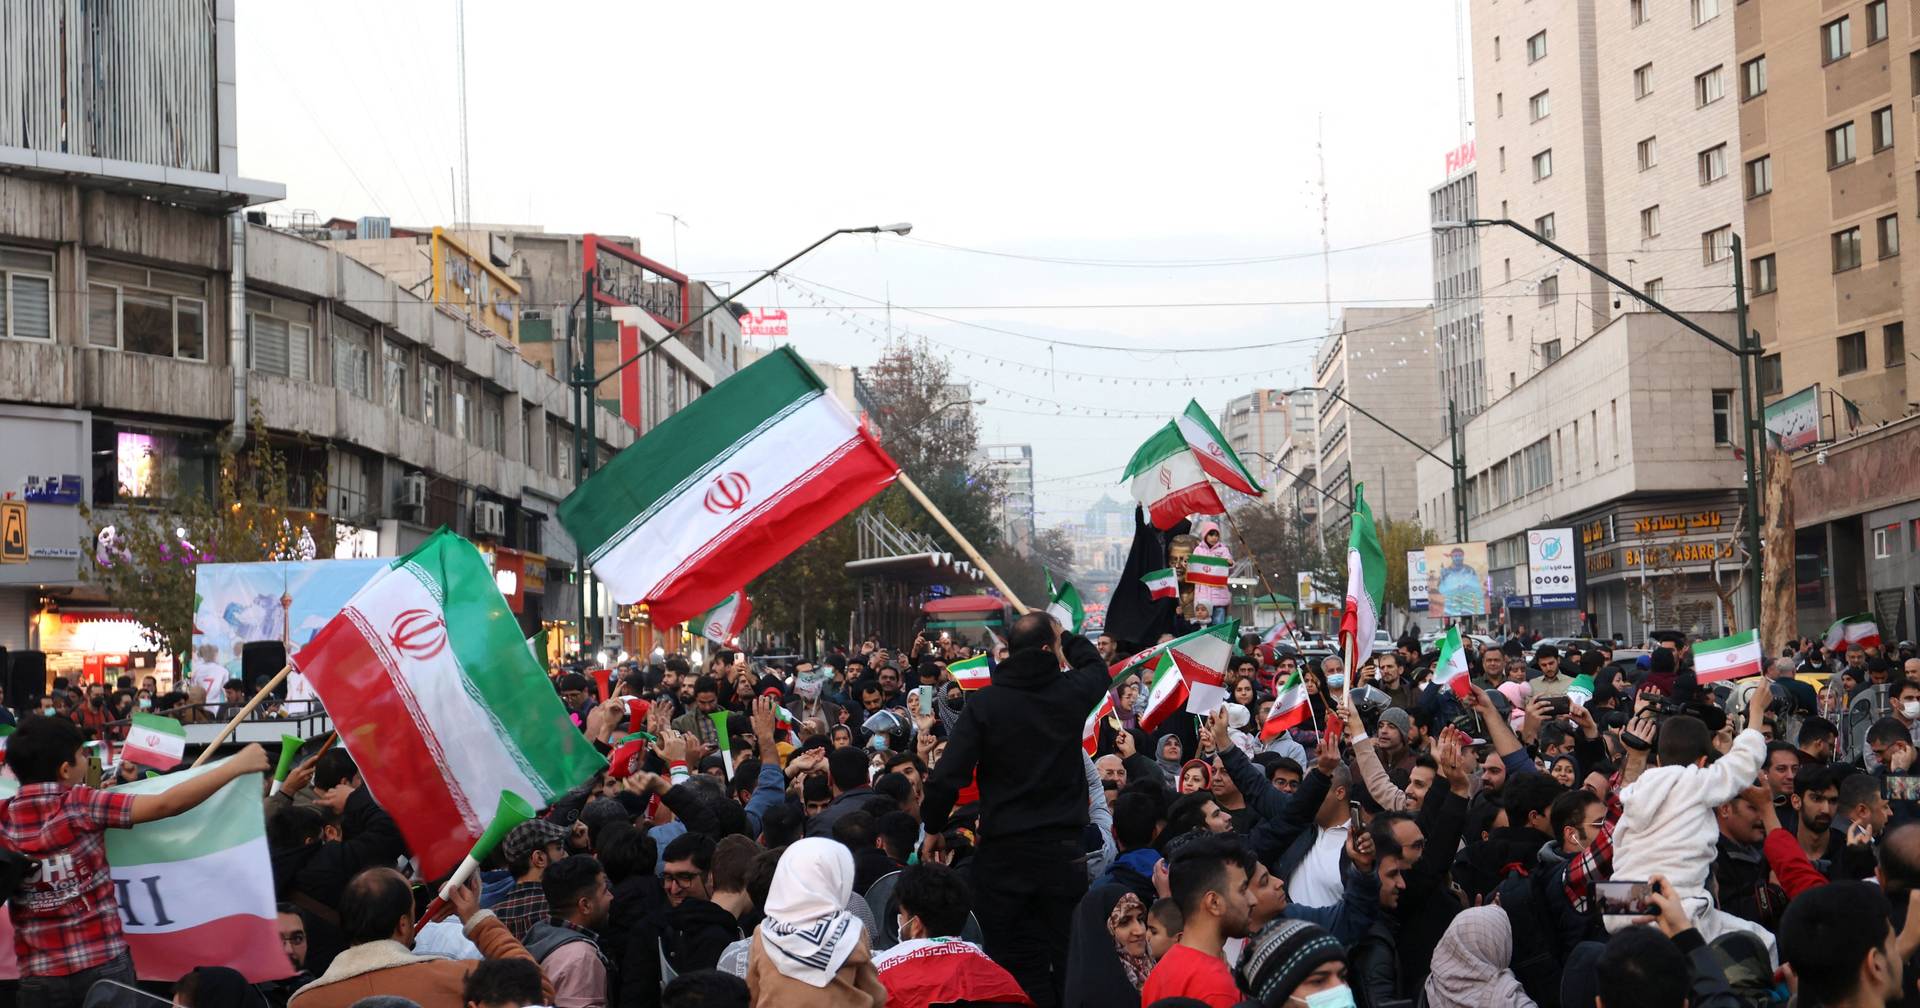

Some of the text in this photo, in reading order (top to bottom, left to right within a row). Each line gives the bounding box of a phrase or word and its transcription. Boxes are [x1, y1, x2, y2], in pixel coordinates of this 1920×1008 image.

[1634, 511, 1721, 535] بانک پاسارگاد
[1665, 543, 1733, 561] ASARGD
[203, 678, 216, 697] 7
